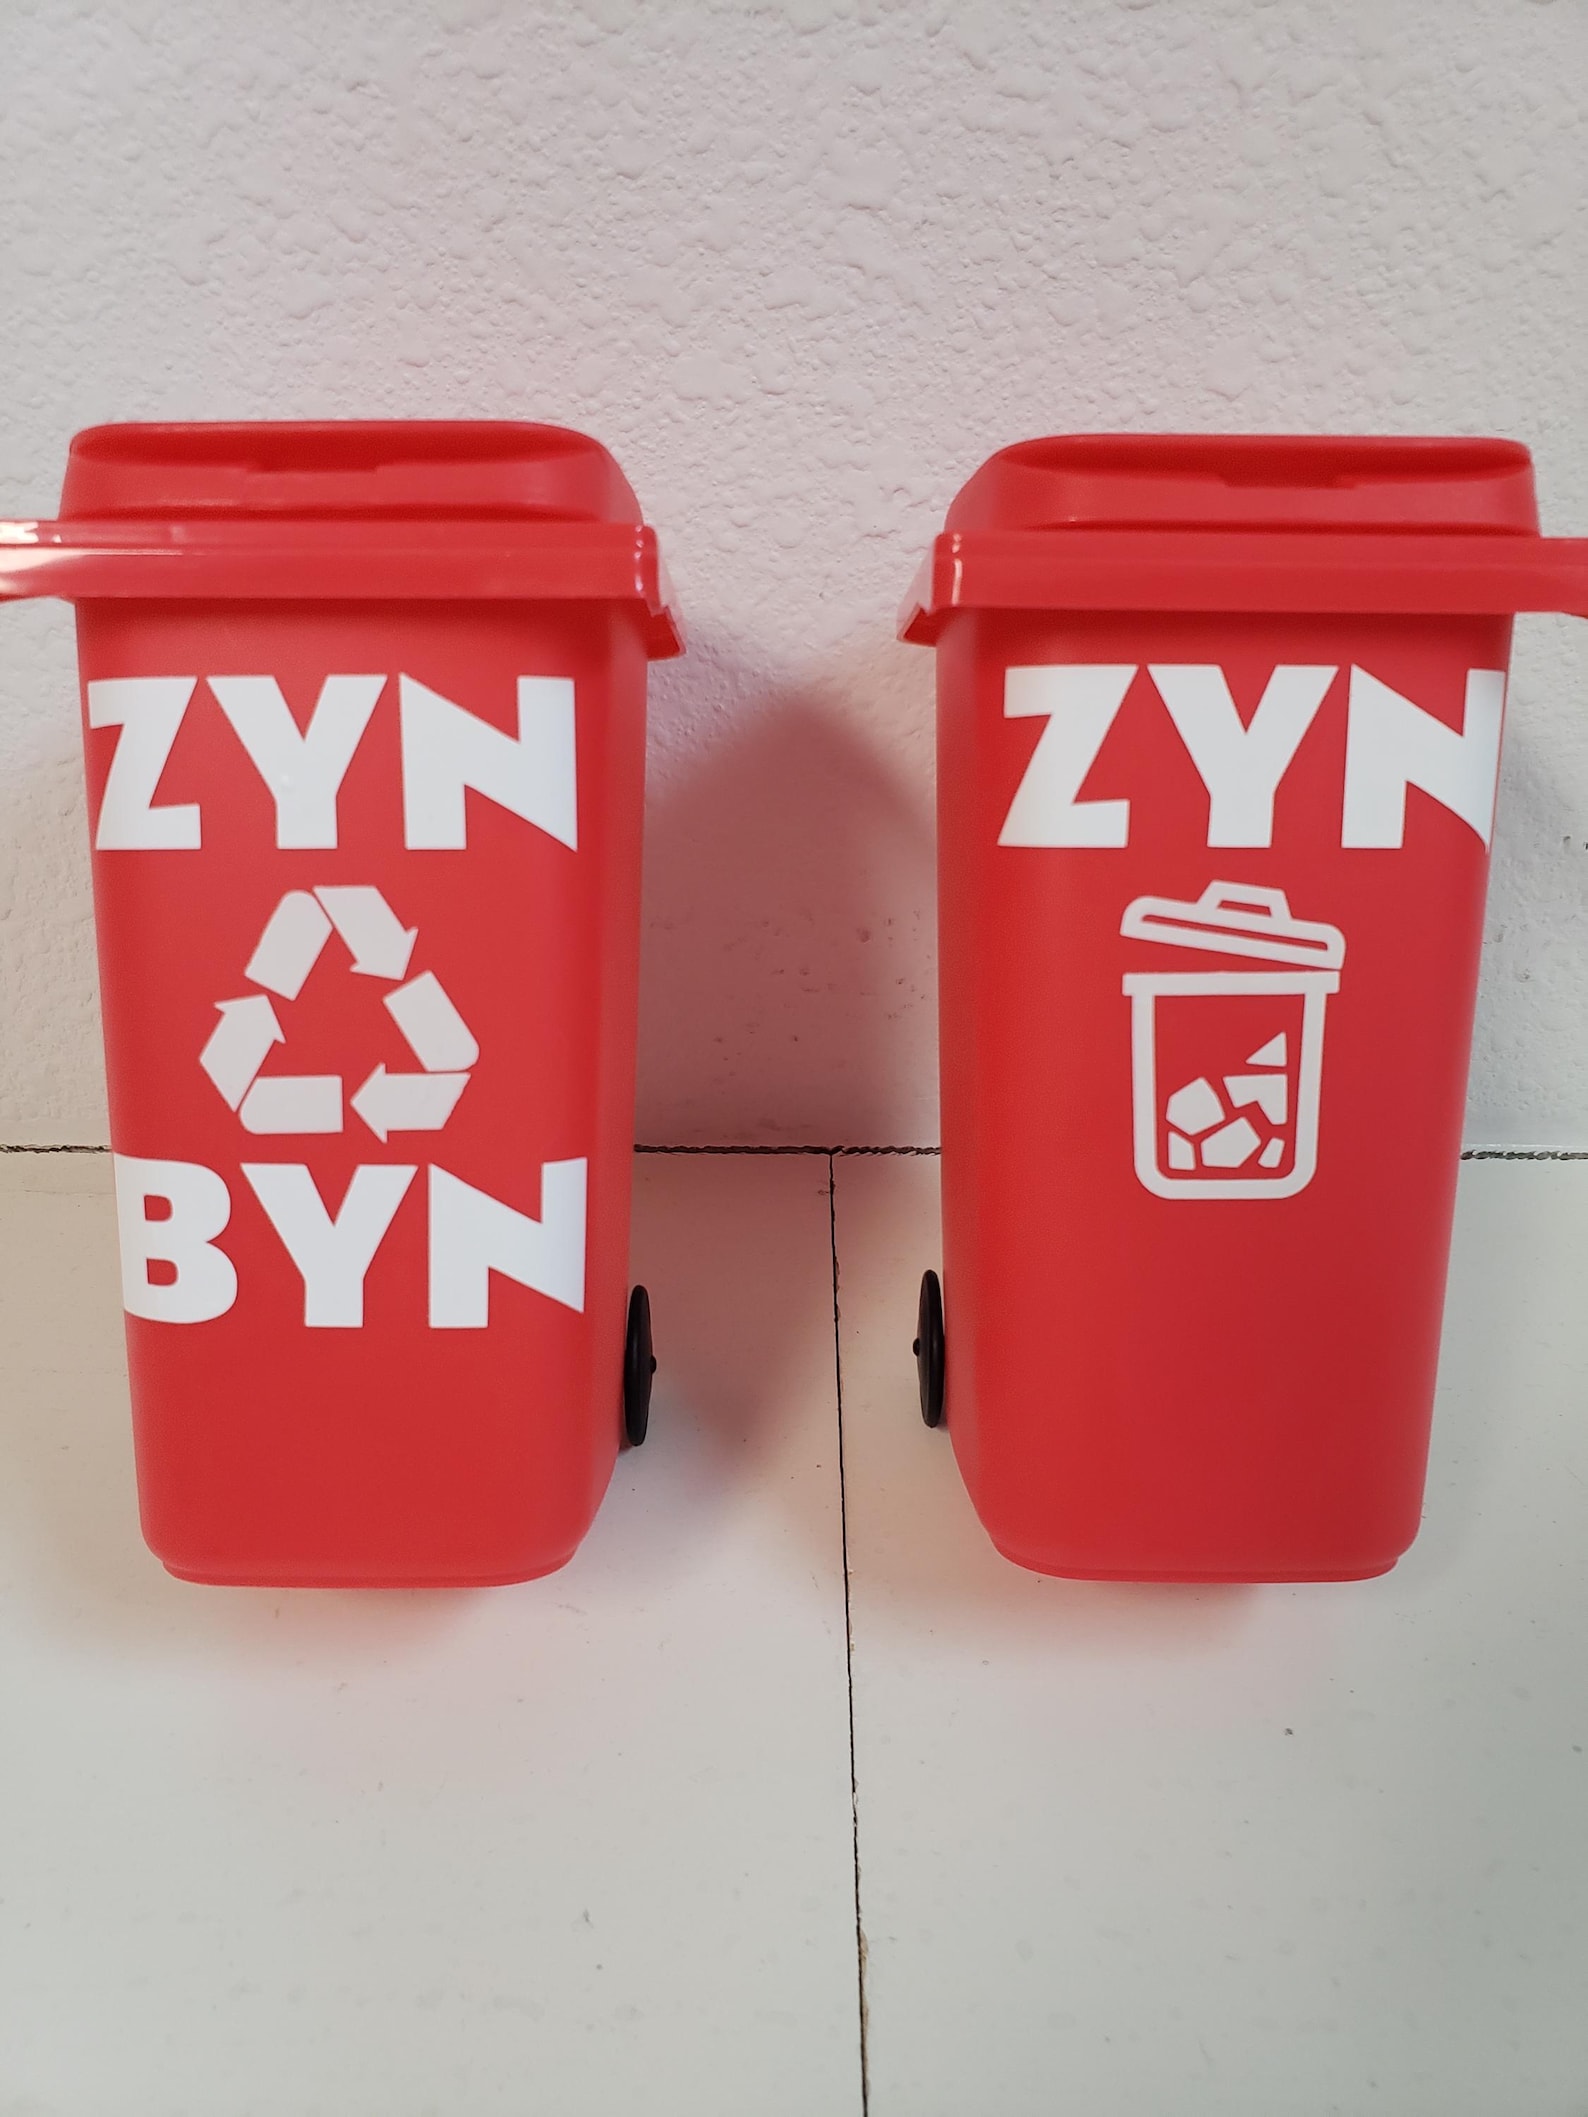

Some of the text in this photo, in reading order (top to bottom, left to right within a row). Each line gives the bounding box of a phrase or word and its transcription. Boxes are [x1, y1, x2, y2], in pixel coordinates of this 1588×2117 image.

[88, 674, 578, 851] ZYN
[998, 664, 1506, 852] ZYN
[114, 1153, 588, 1329] BYN
